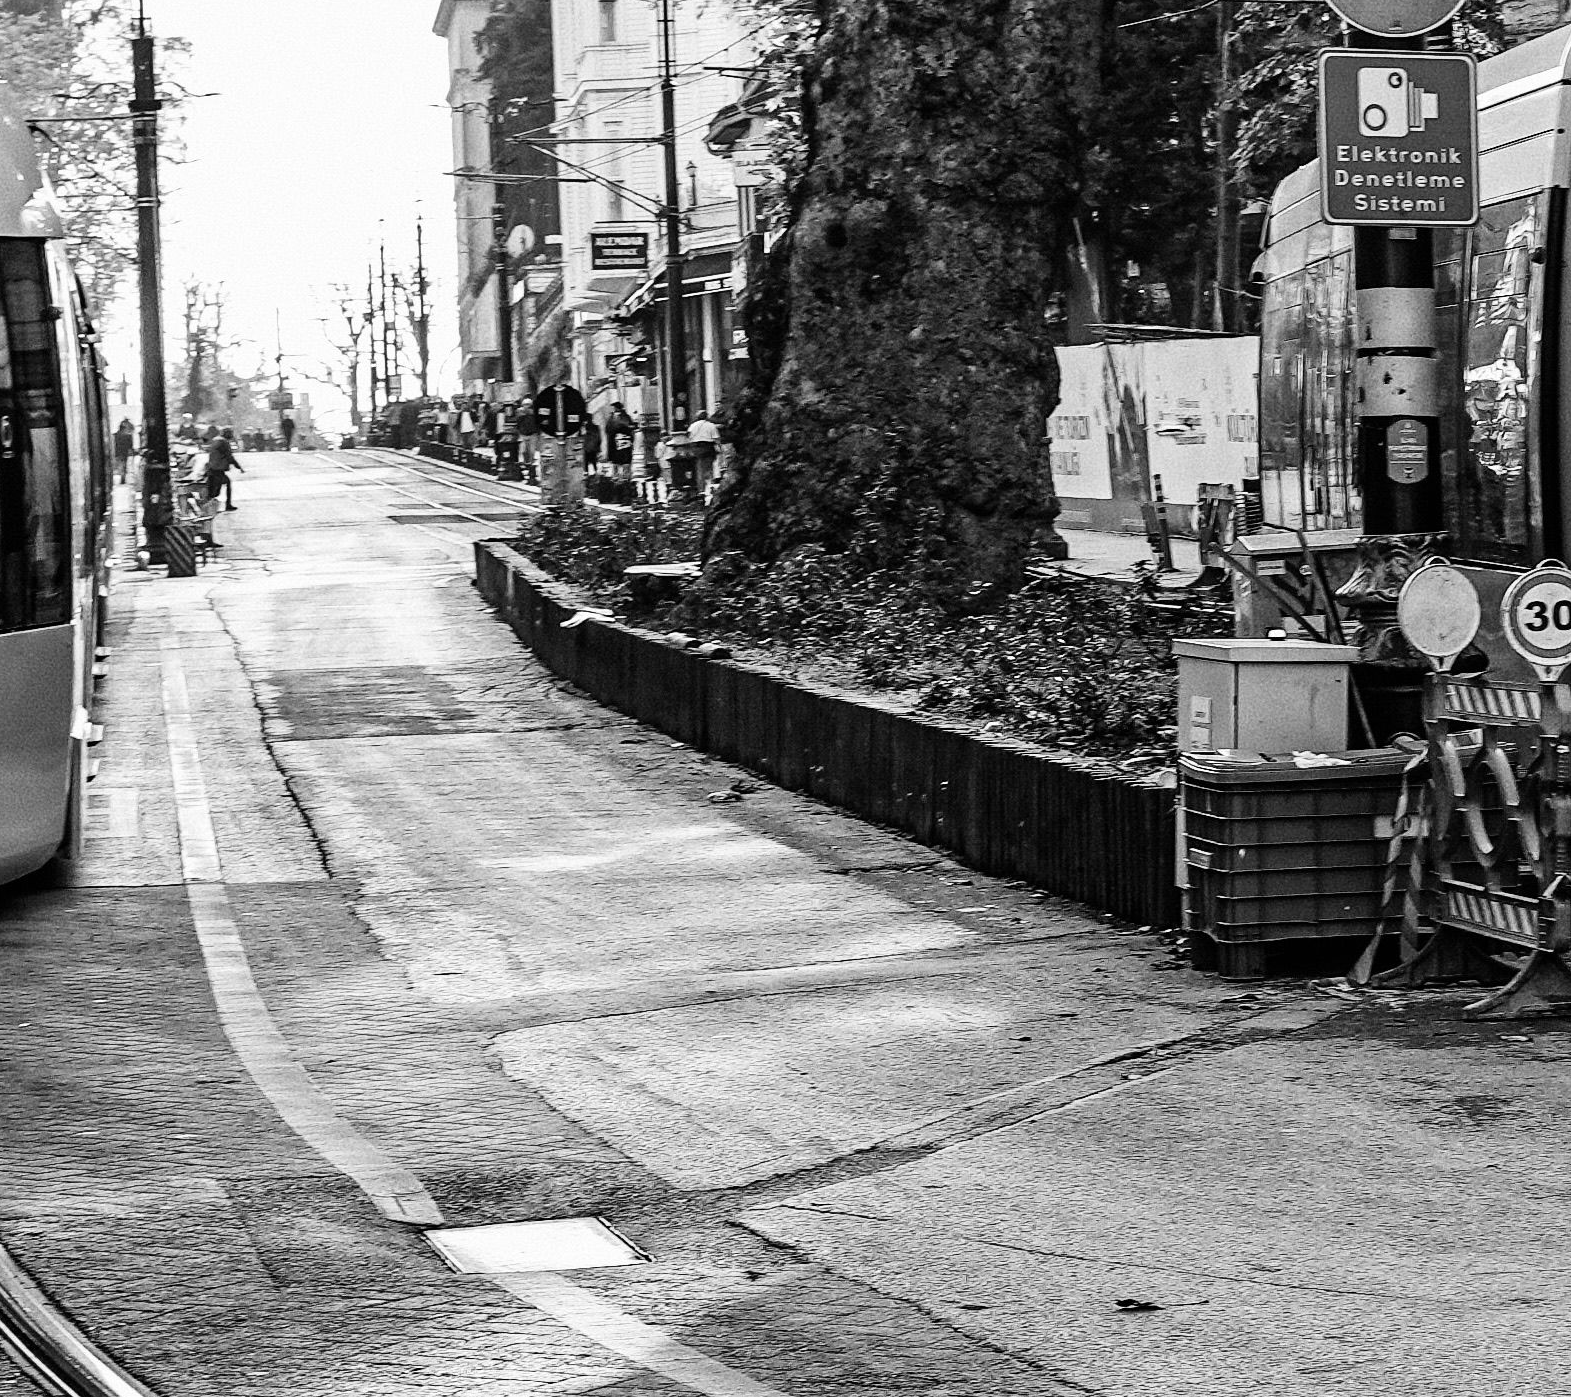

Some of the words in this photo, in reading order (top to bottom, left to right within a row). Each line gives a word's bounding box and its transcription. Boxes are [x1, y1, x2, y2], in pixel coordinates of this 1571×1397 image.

[1336, 145, 1462, 164] Elektronik
[1334, 169, 1466, 188] Denetleme
[1354, 193, 1446, 212] Sistemi
